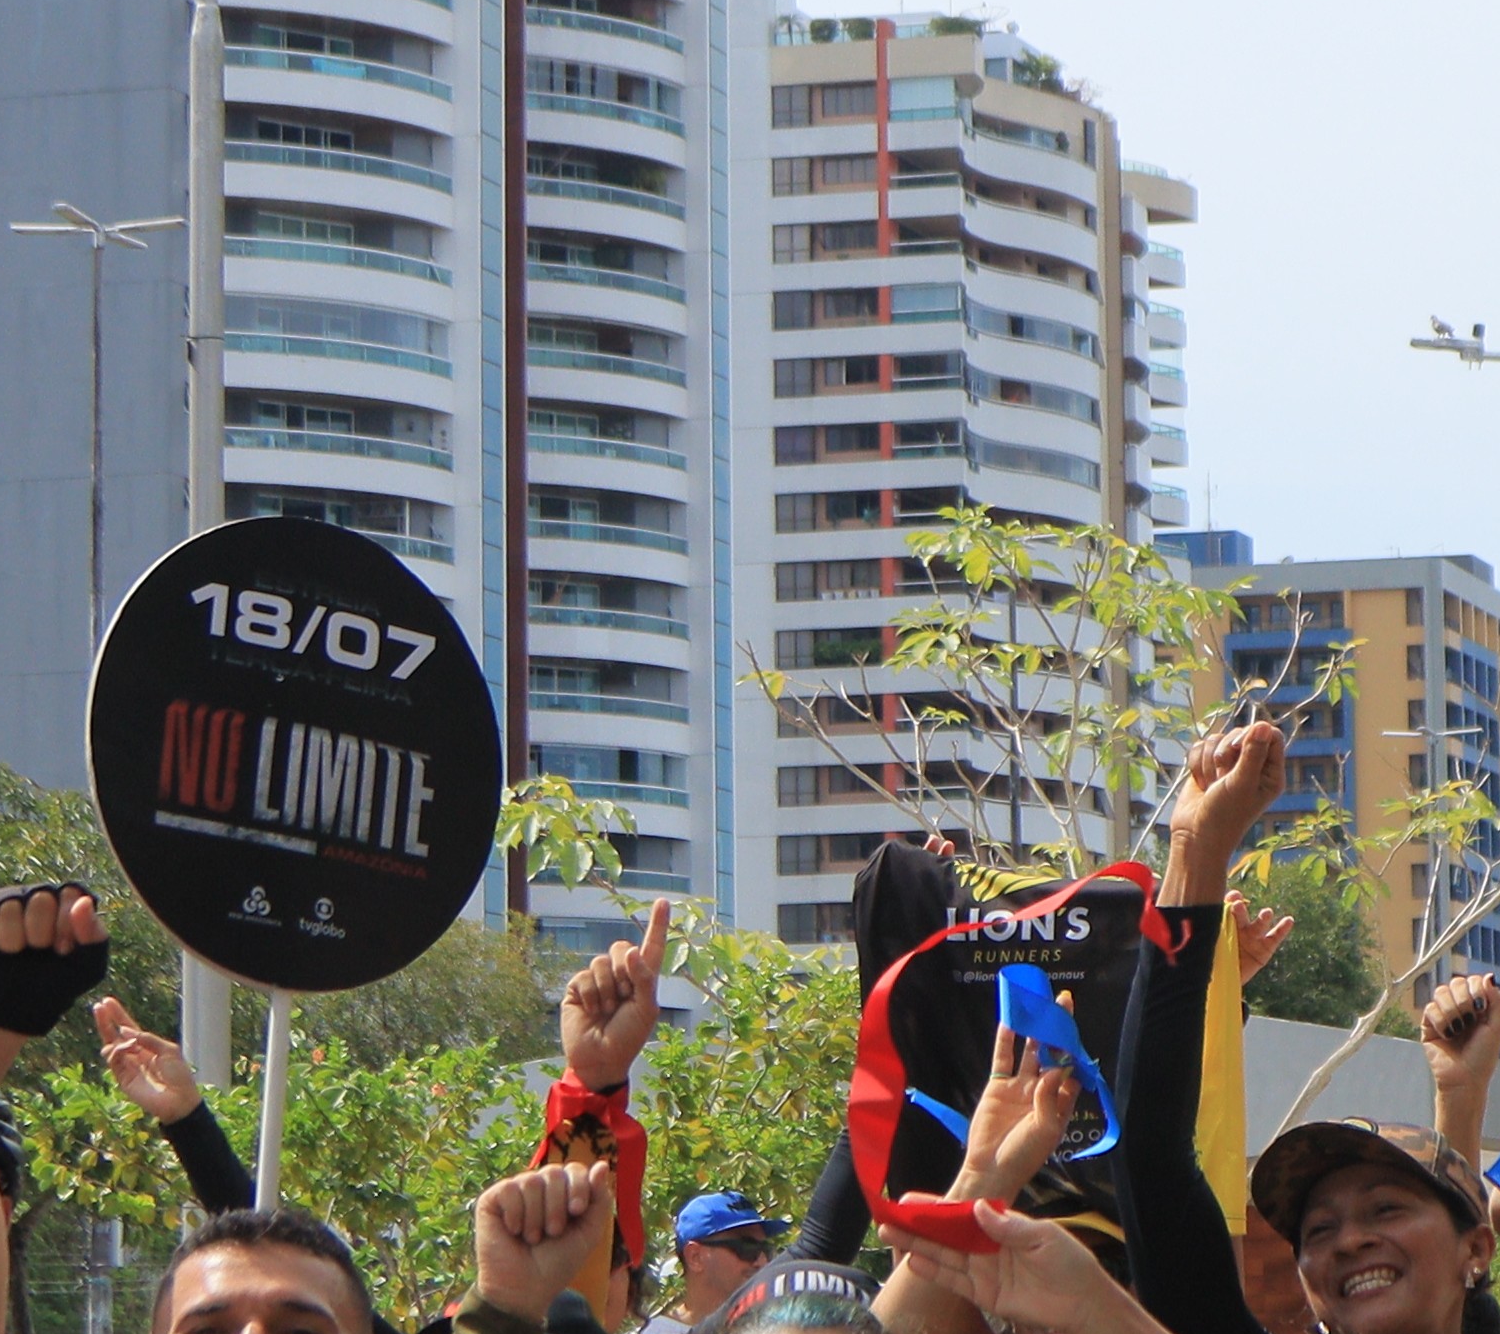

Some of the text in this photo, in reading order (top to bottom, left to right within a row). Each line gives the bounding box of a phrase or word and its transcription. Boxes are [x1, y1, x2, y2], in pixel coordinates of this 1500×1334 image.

[189, 581, 438, 681] 18/07
[158, 698, 437, 858] NO LIMITE
[946, 906, 1092, 942] LION'S
[973, 948, 1062, 963] RUNNERS
